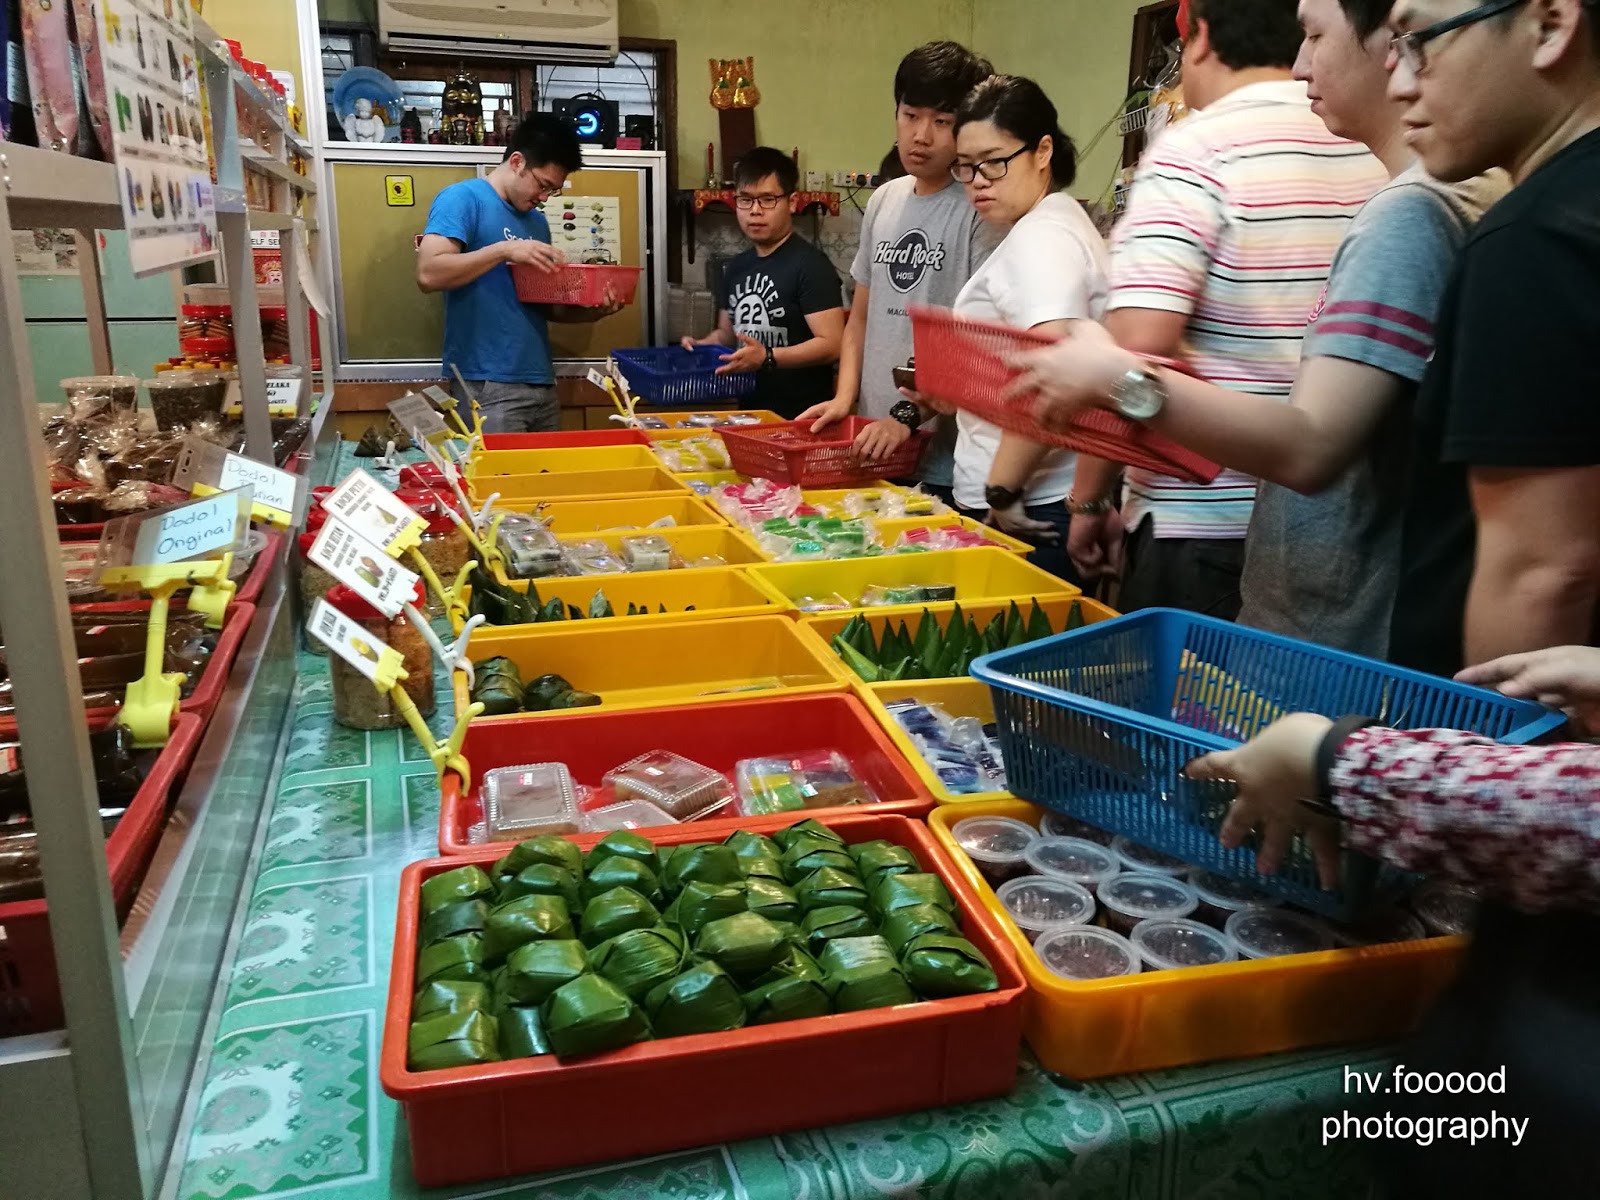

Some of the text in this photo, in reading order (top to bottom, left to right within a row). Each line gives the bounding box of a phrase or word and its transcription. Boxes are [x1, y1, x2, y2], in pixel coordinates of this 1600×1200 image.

[251, 238, 265, 246] ELF
[874, 241, 946, 271] Hard Rock
[895, 271, 915, 280] HOTEL
[740, 302, 763, 325] 22
[226, 458, 276, 485] Dodol
[161, 503, 218, 531] Dodol
[156, 518, 233, 555] Original
